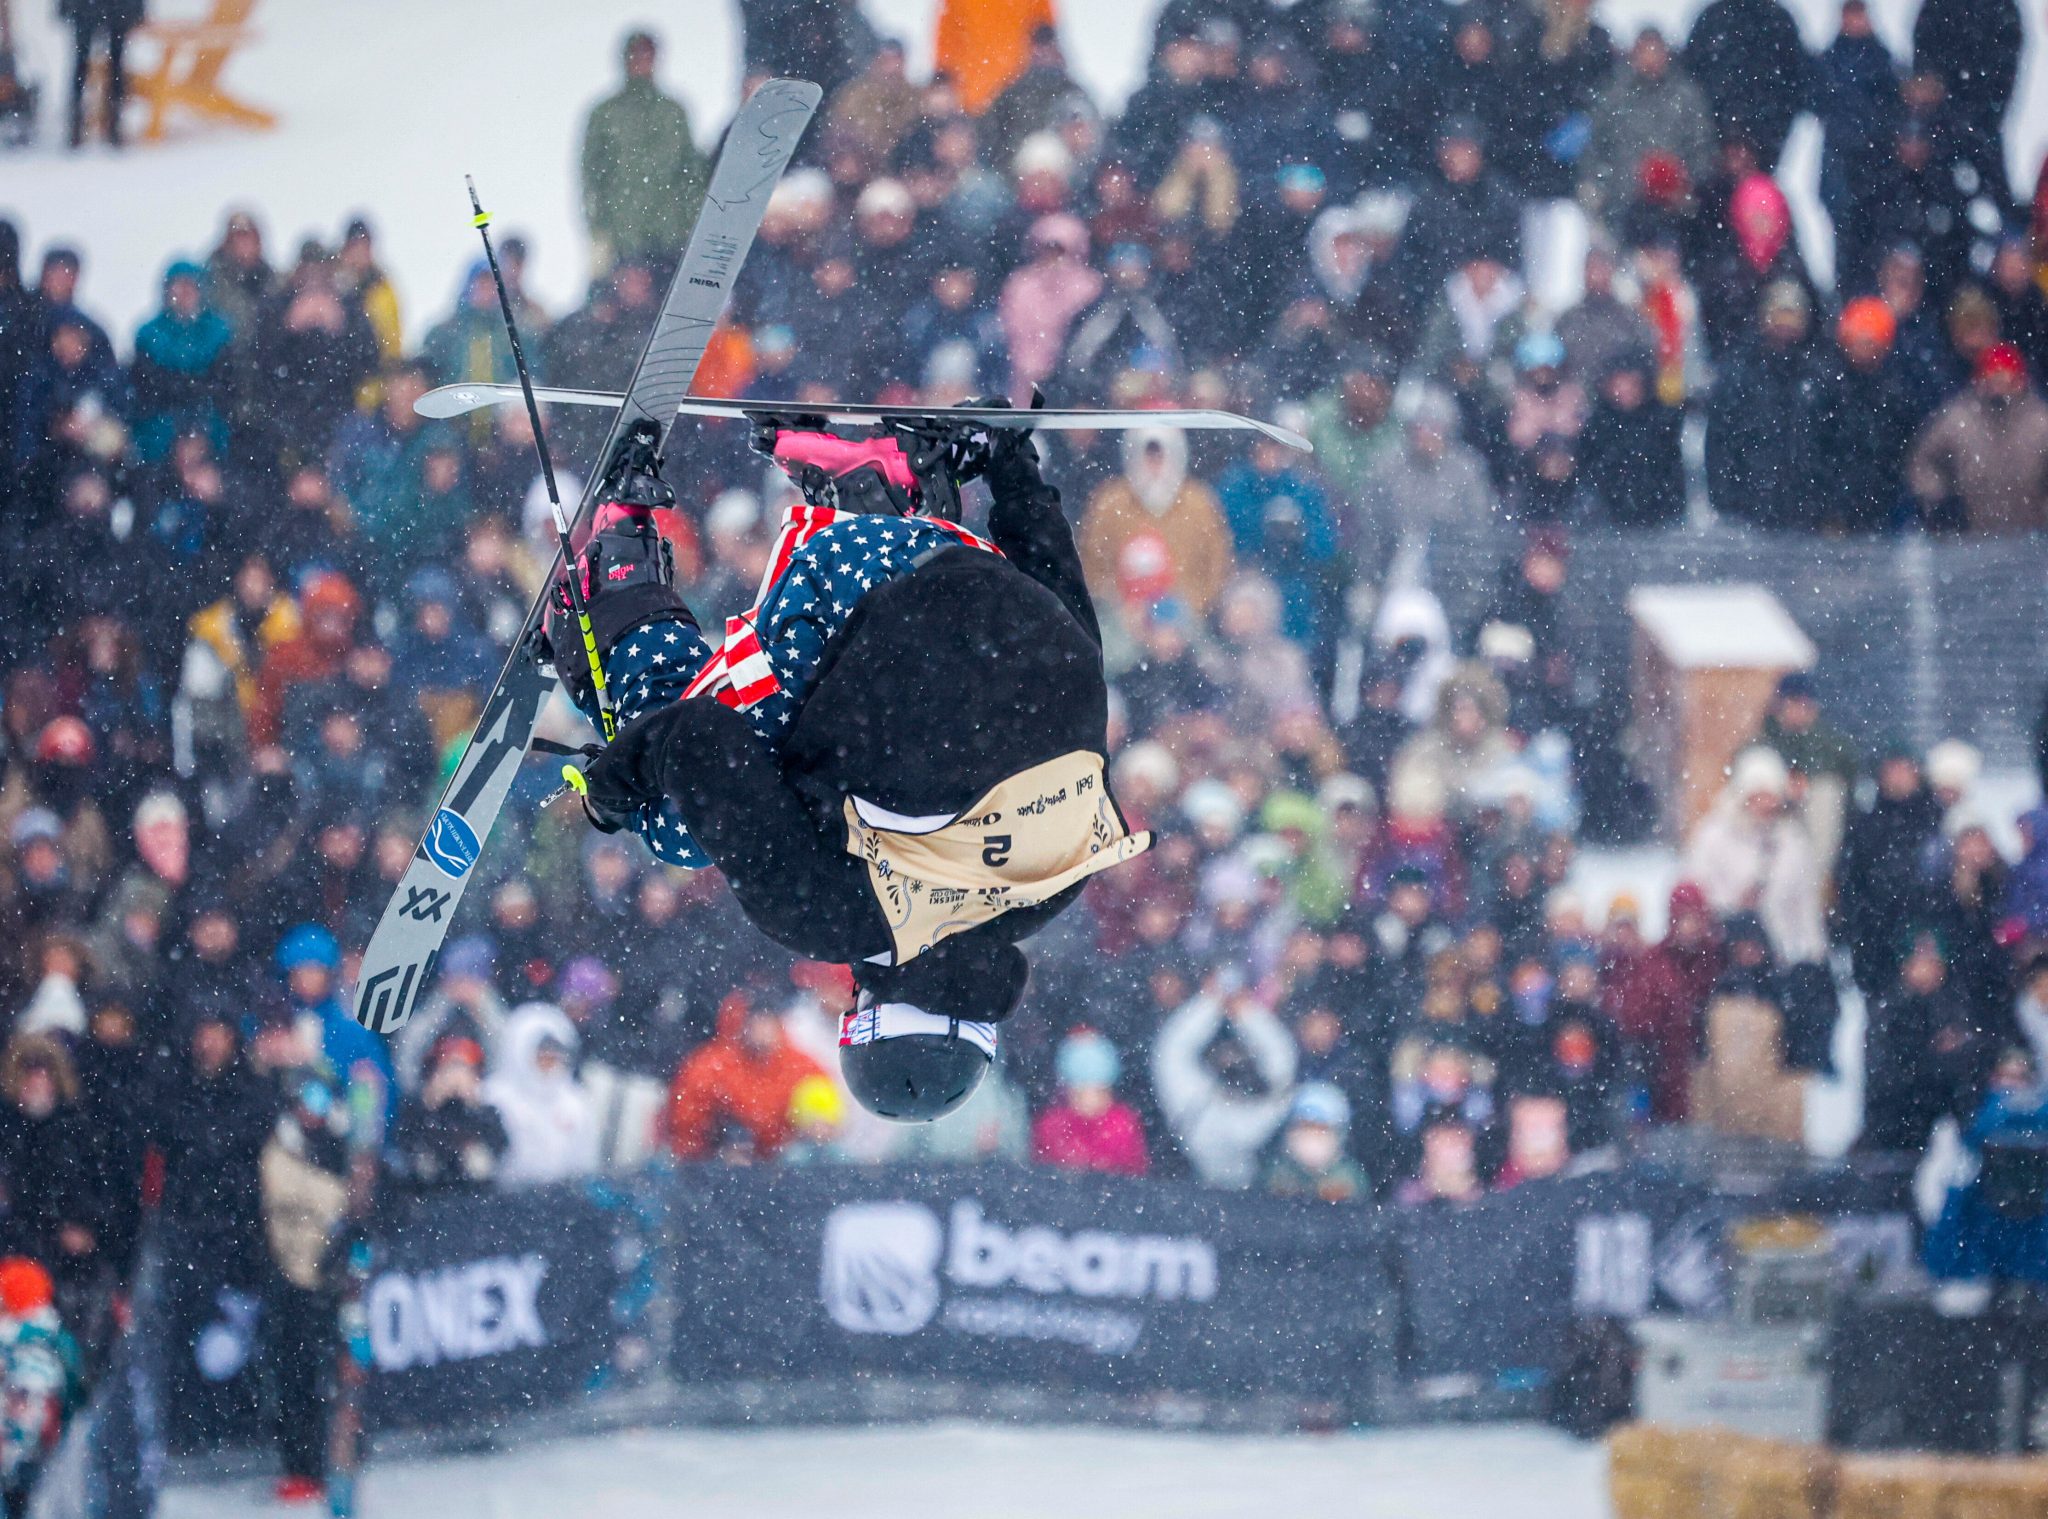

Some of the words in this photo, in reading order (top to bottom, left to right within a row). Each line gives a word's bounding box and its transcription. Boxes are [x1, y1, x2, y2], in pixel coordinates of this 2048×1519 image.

[1076, 774, 1094, 797] Bell
[982, 834, 1012, 867] 2
[929, 893, 965, 904] FREESKI
[948, 1198, 1217, 1300] beam
